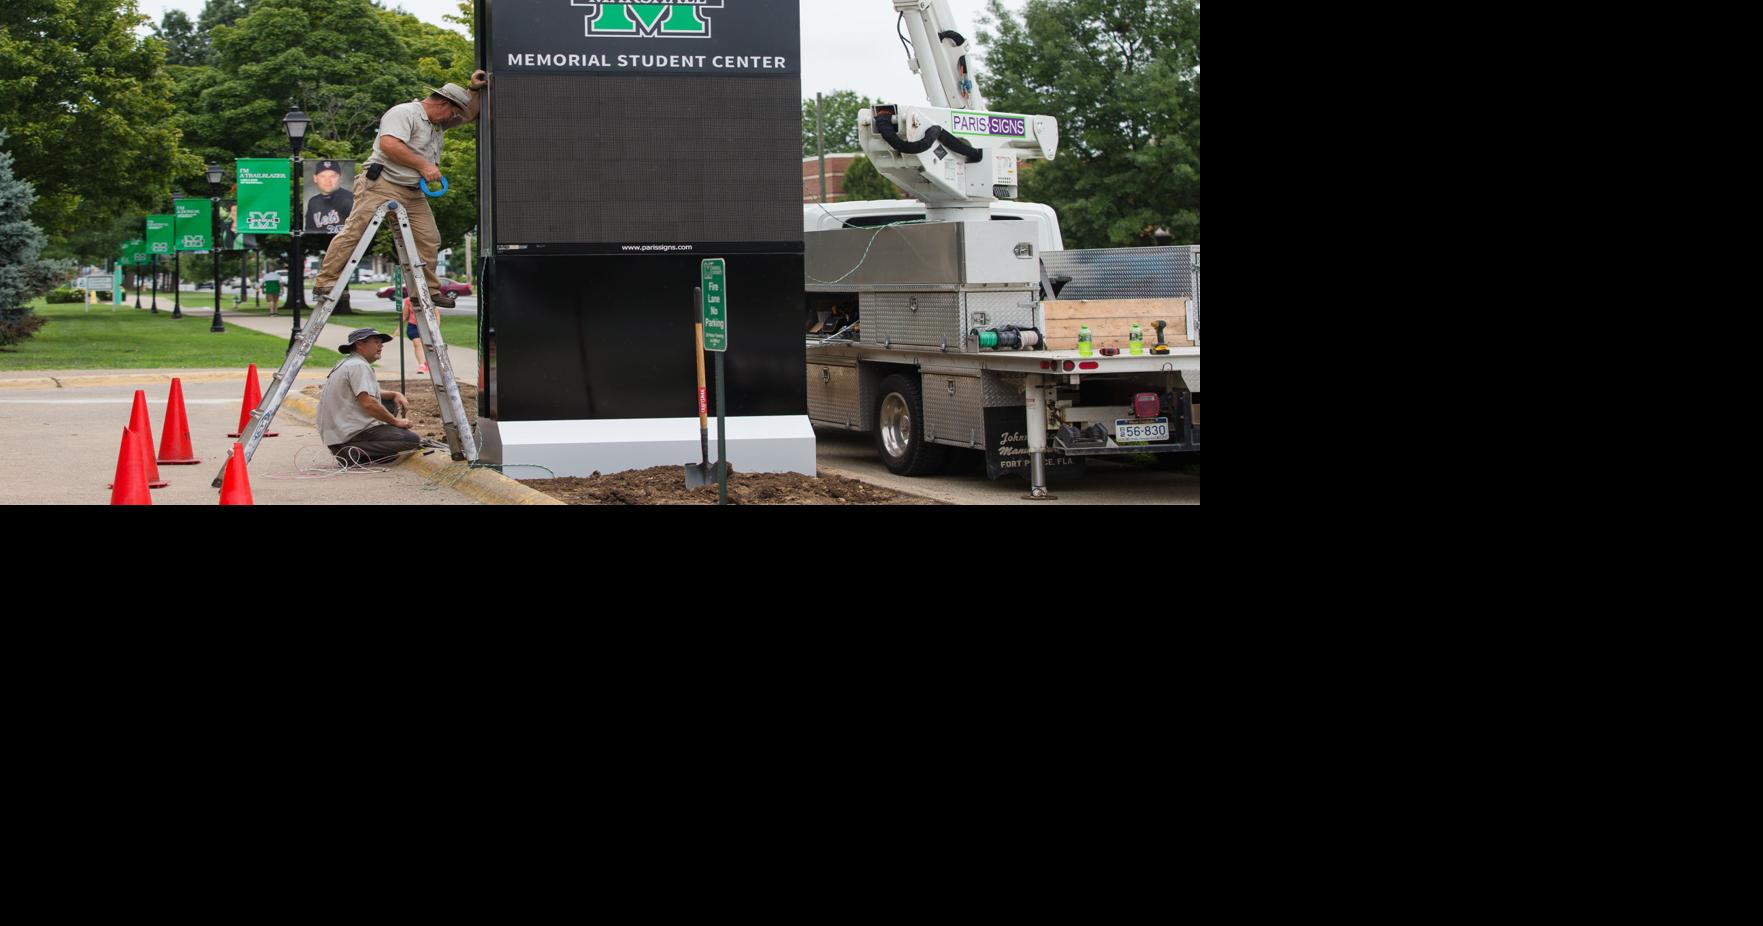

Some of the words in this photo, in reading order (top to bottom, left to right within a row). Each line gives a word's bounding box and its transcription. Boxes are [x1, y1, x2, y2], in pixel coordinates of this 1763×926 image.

[507, 53, 611, 67] MEMORIAL
[617, 54, 706, 68] STUDENT
[712, 55, 786, 69] CENTER
[953, 115, 987, 132] PARIS
[991, 118, 1025, 134] SIGNS
[621, 244, 693, 252] www.parissigns.com
[708, 281, 720, 291] Fire
[707, 294, 721, 303] Lane
[710, 306, 719, 315] No
[705, 318, 724, 329] Parking
[1000, 460, 1021, 468] FORT
